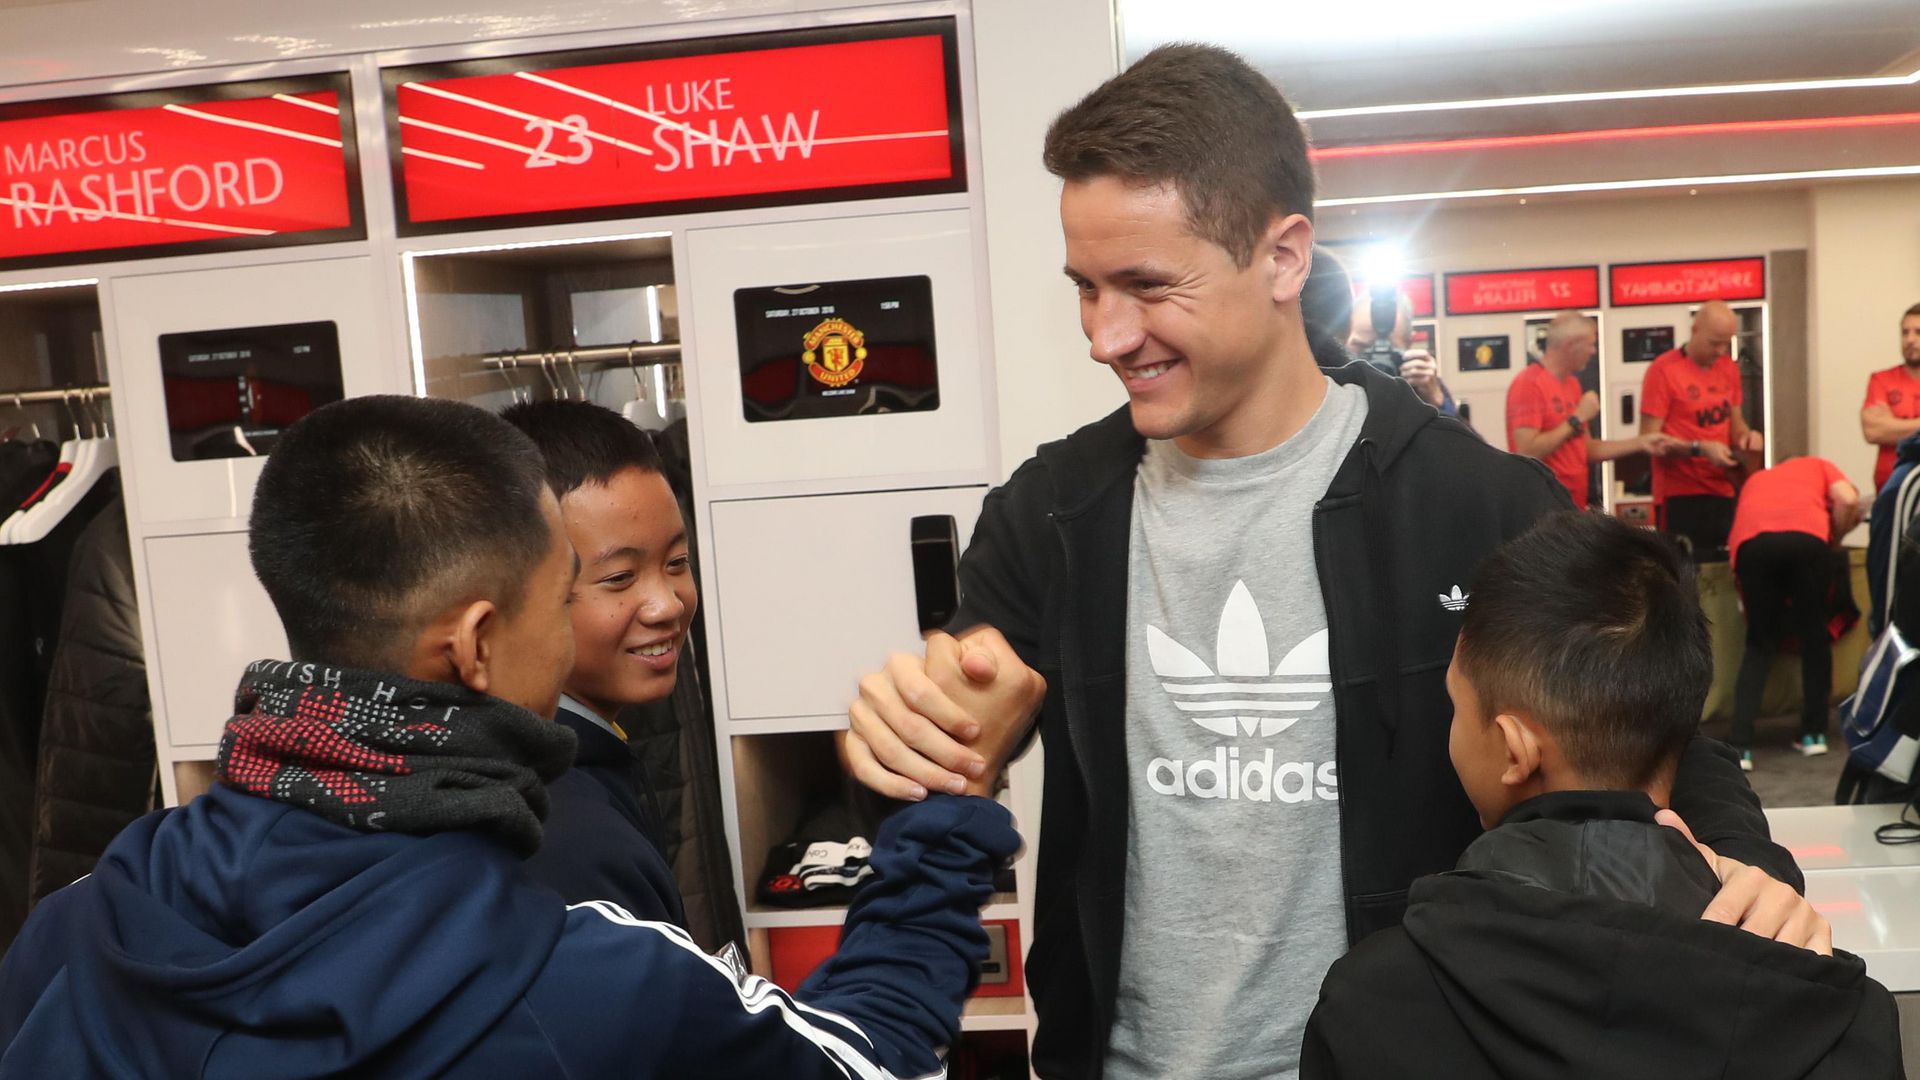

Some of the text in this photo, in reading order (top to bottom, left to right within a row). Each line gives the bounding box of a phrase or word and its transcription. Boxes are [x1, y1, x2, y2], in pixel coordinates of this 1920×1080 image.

[646, 78, 735, 116] LUKE
[4, 131, 147, 176] MARCUS
[524, 114, 594, 169] 23
[652, 110, 820, 172] SHAW
[9, 157, 284, 229] RASHFORD
[807, 320, 862, 347] MANCHESTER
[819, 367, 857, 383] UNITED
[1146, 745, 1340, 804] adidas
